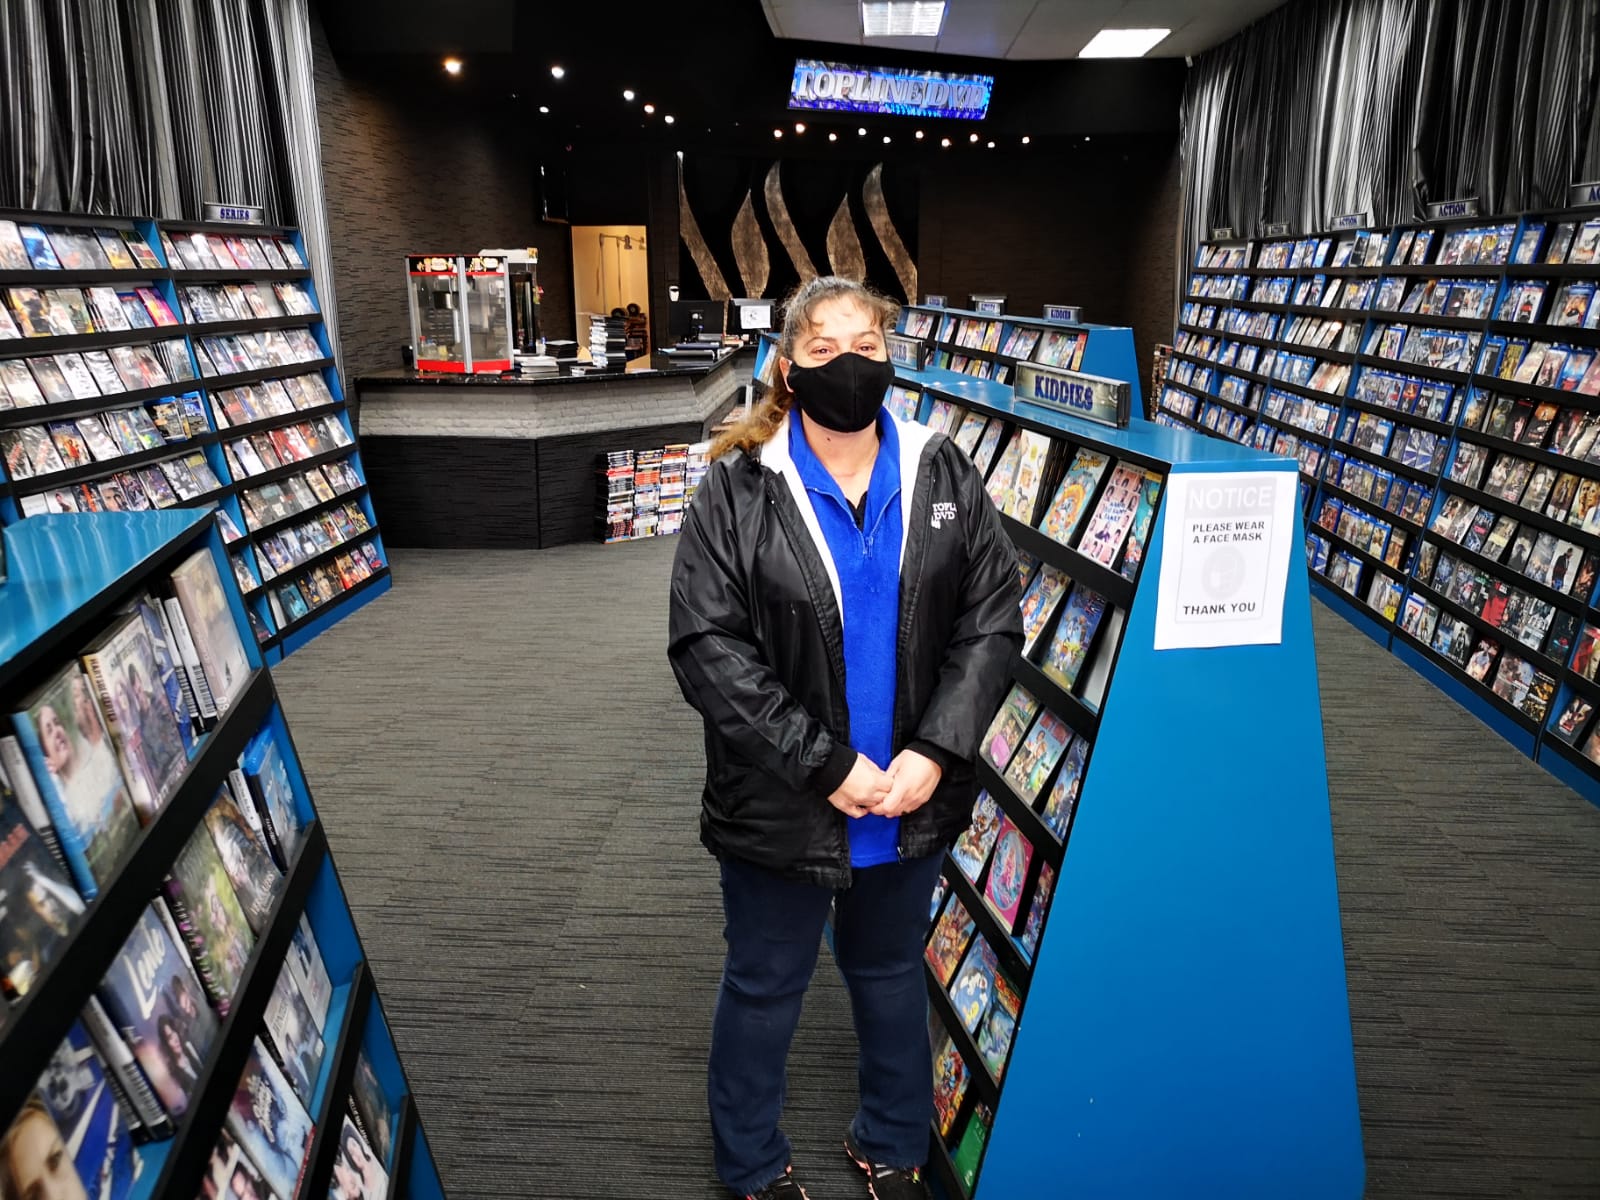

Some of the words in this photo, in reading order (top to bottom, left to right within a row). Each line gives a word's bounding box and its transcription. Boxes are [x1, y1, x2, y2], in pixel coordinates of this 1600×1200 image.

[795, 67, 926, 105] TOPLINE
[923, 79, 987, 109] DVD
[220, 208, 249, 220] SERIES
[1438, 203, 1466, 217] ACTION
[1338, 215, 1357, 226] ACTION
[1034, 374, 1093, 411] KIDDIES
[1189, 486, 1272, 510] NOTICE
[933, 511, 955, 520] DVD
[1192, 523, 1232, 533] PLEASE
[1235, 521, 1264, 530] WEAR
[1192, 535, 1200, 544] A
[1203, 534, 1230, 543] FACE
[1232, 532, 1262, 542] MASK
[1183, 604, 1226, 615] THANK
[1231, 602, 1256, 613] YOU
